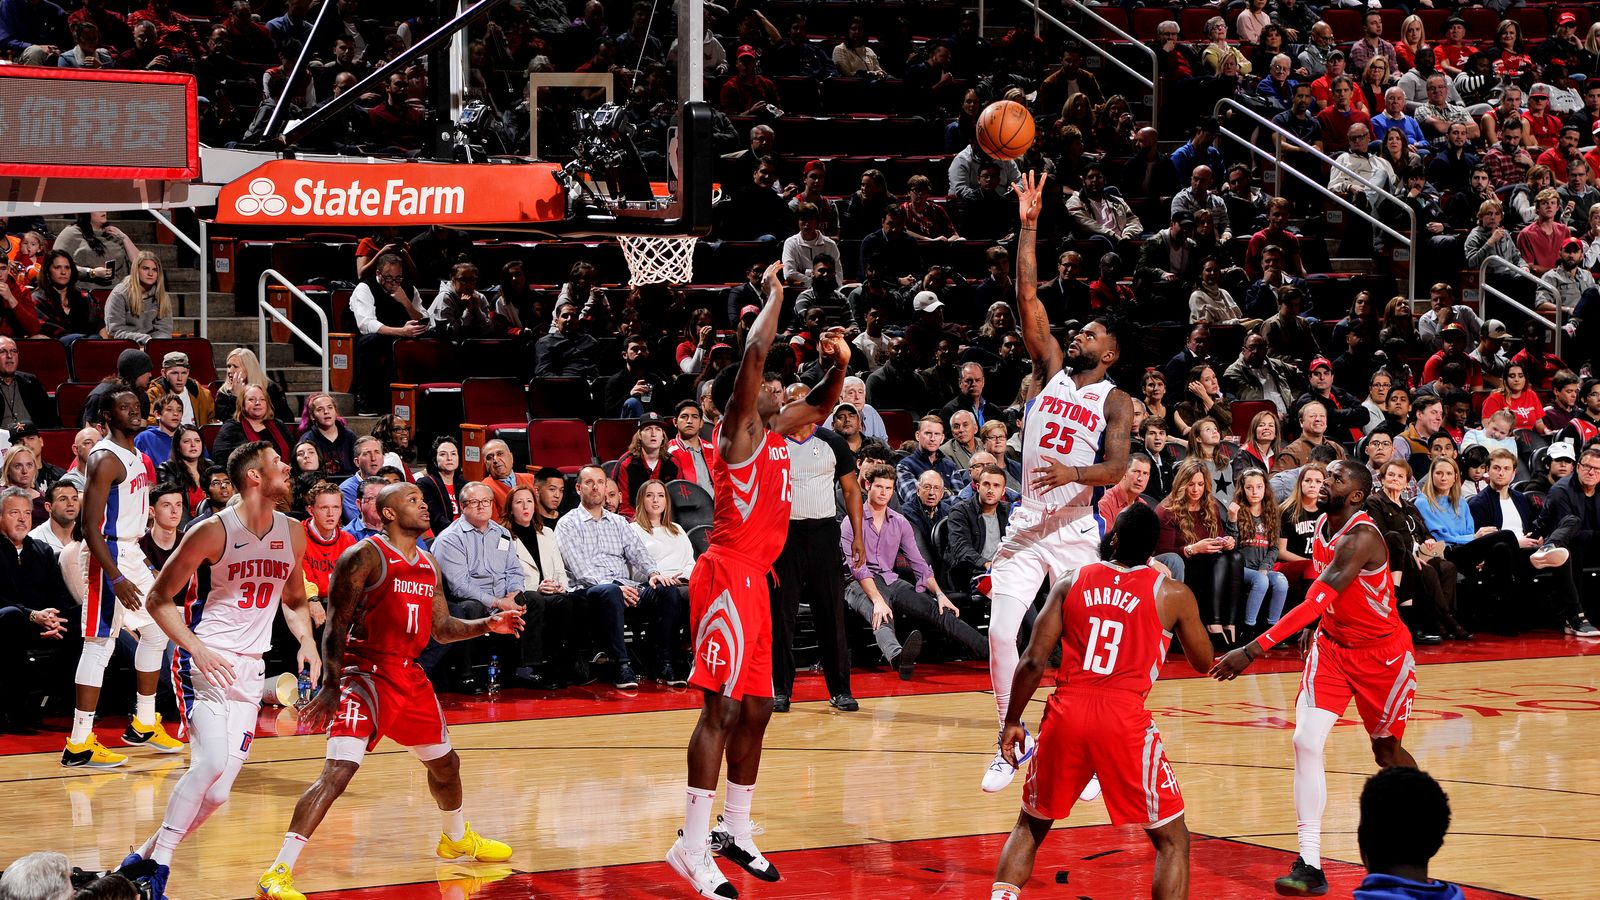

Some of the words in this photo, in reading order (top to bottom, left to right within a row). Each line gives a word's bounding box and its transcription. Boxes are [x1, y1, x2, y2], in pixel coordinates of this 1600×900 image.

[1039, 395, 1101, 433] PISTONS
[1039, 421, 1077, 455] 25
[227, 558, 290, 581] PISTONS
[238, 581, 274, 609] 30
[393, 577, 434, 598] ROCKETS
[1083, 587, 1141, 614] HARDEN
[406, 602, 420, 635] 17
[1082, 616, 1124, 675] 13
